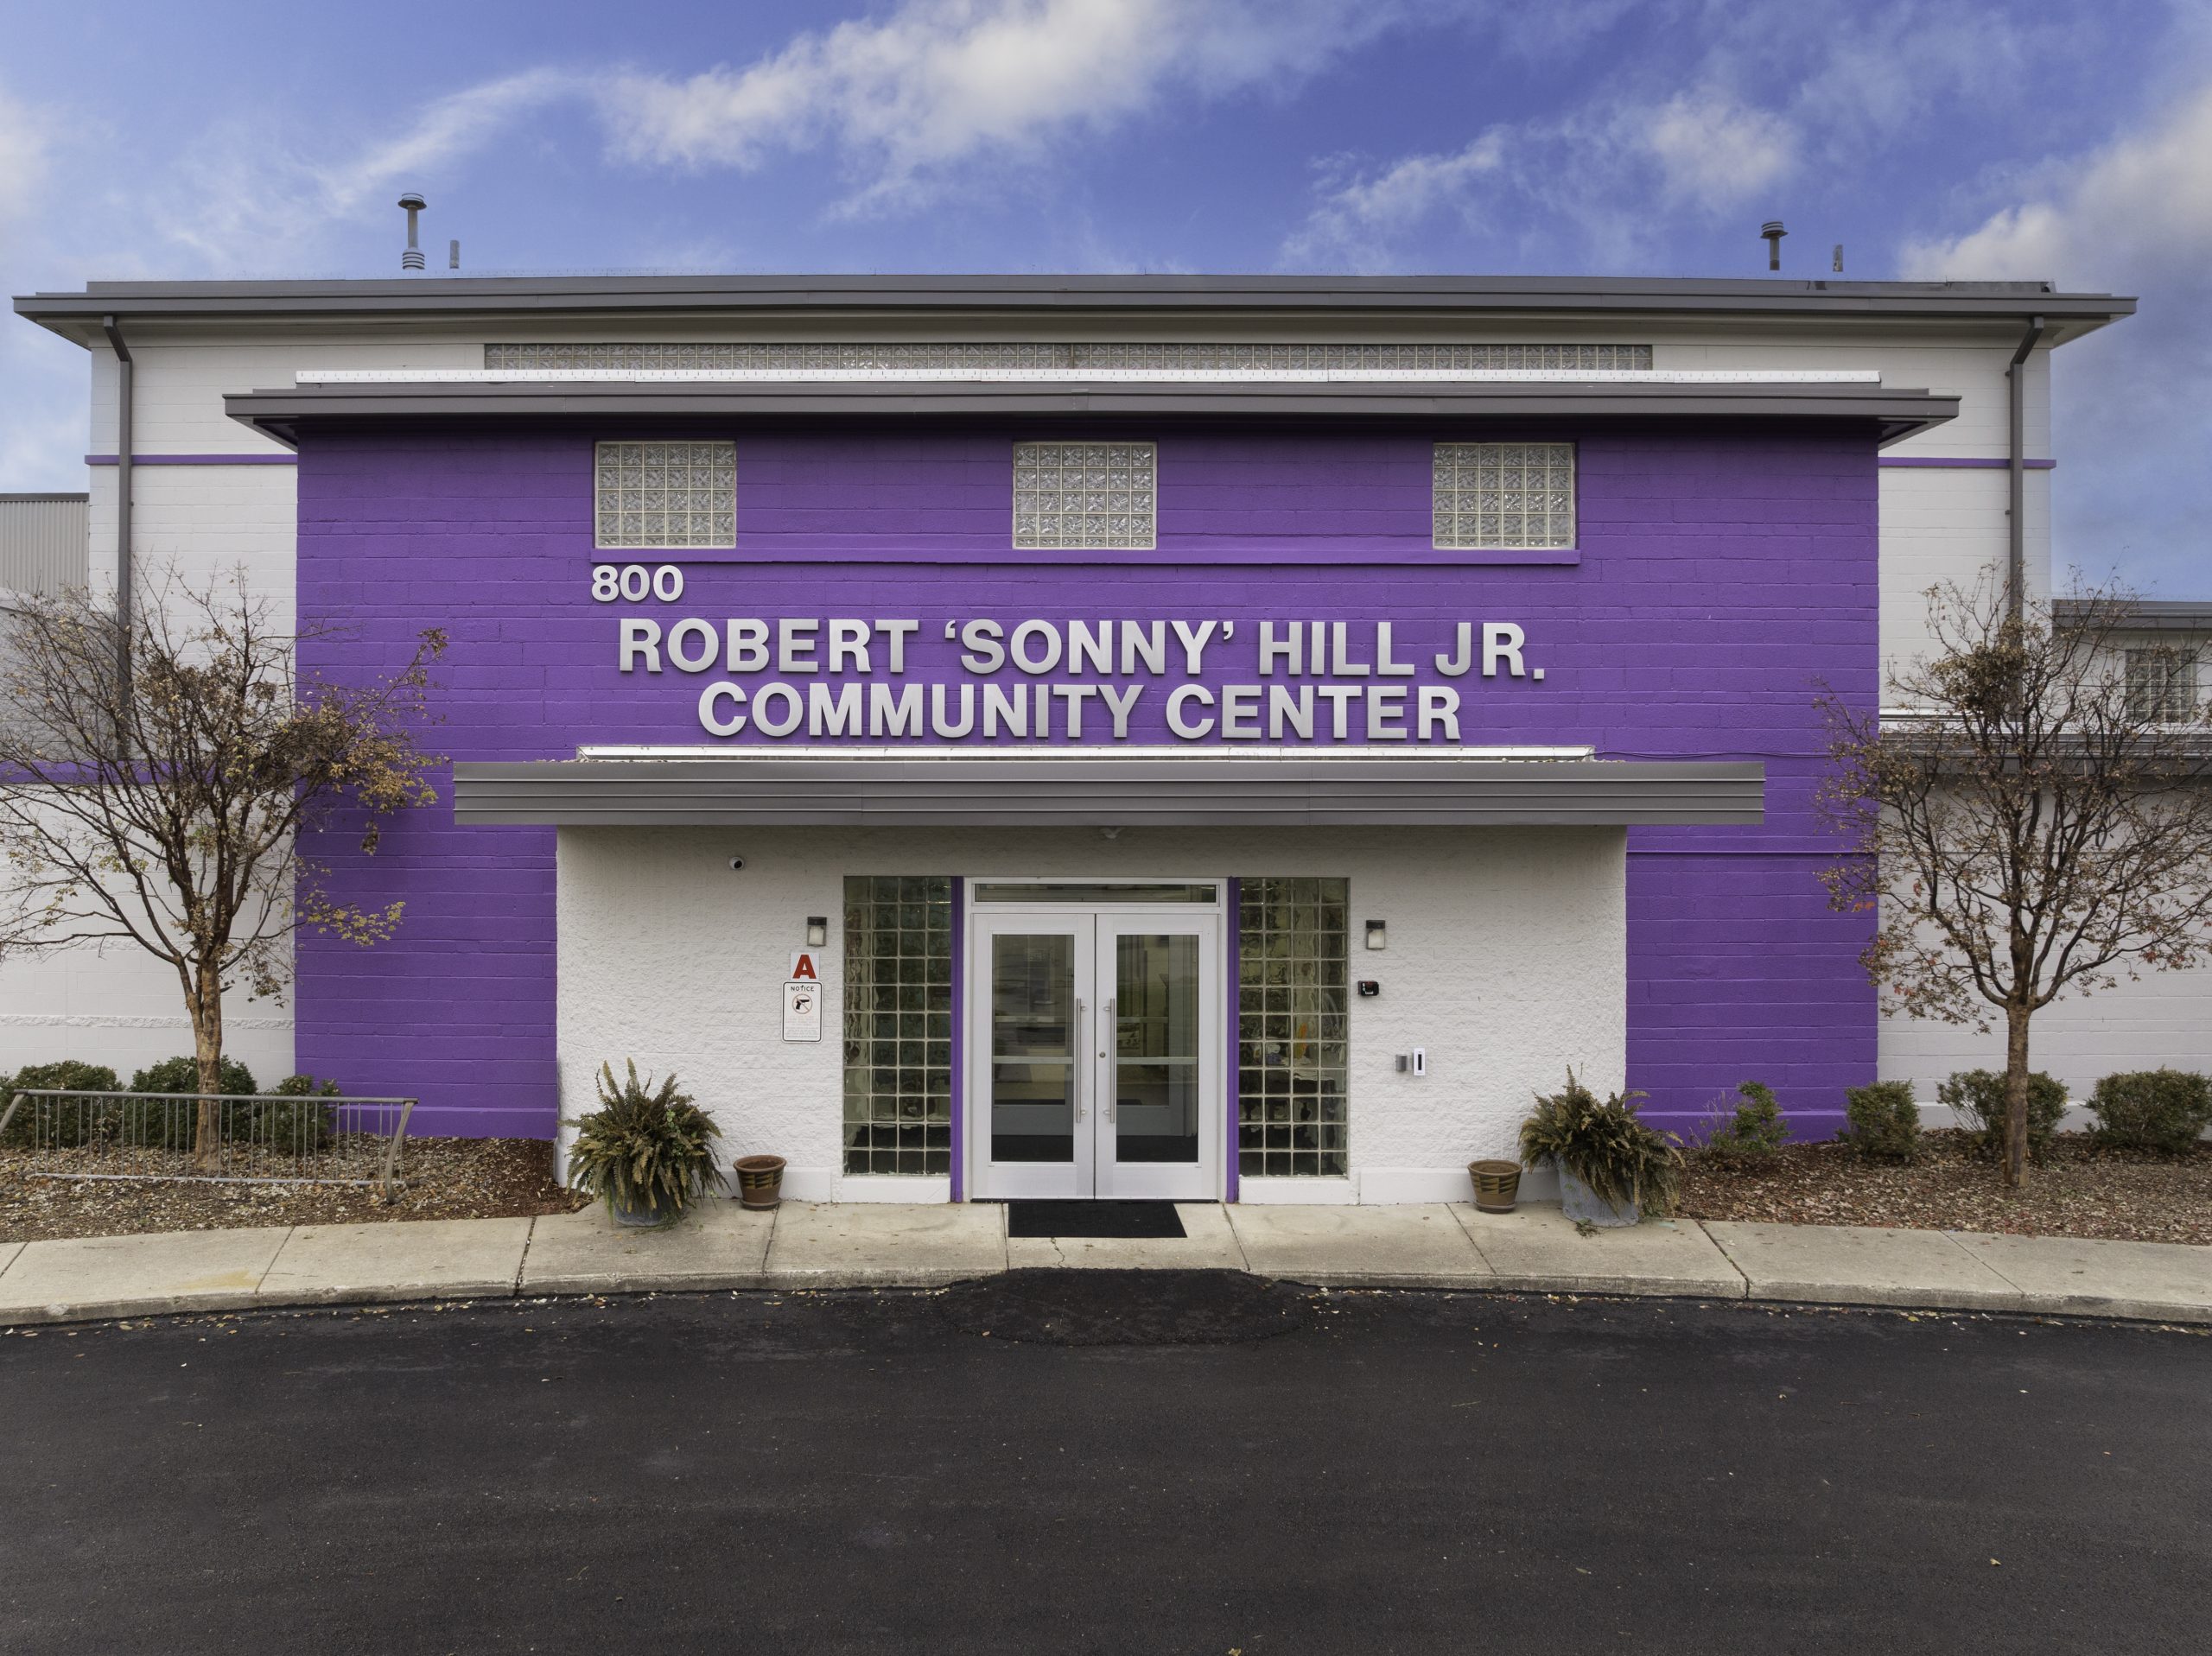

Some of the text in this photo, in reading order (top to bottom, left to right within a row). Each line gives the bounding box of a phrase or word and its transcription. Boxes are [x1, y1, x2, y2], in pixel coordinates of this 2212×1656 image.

[591, 565, 683, 602] 800
[619, 618, 919, 674] ROBERT
[1258, 620, 1415, 676] HILL
[1434, 621, 1545, 680] JR.
[698, 681, 1462, 740] COMMUNITY CENTER
[792, 954, 817, 980] A
